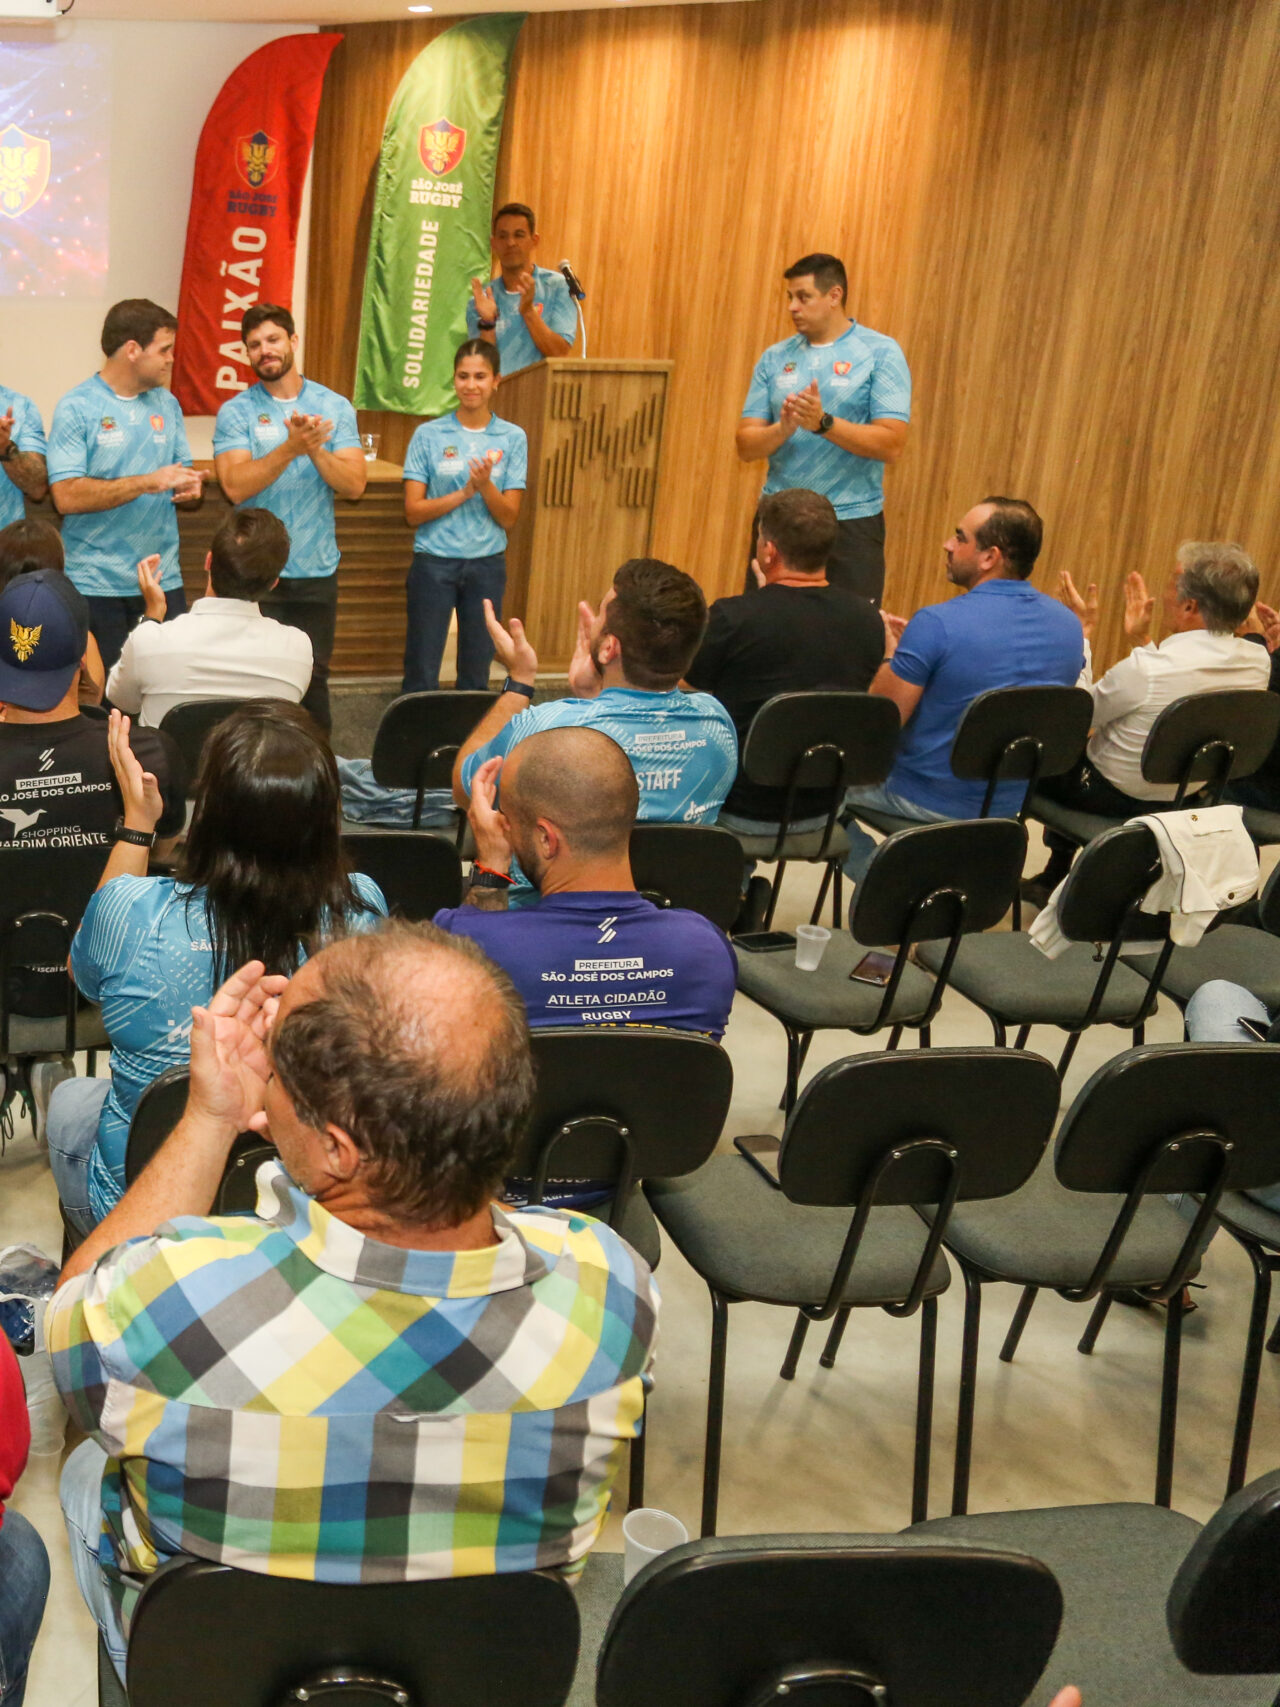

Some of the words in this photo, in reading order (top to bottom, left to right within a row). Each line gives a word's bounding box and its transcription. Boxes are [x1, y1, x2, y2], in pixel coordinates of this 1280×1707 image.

[411, 177, 434, 190] SÃO
[433, 181, 463, 194] JOSÉ
[409, 190, 463, 208] RUGBY
[227, 201, 277, 217] RUGBY
[215, 226, 267, 391] PAIXÃO
[402, 219, 439, 389] SOLIDARIEDADE
[654, 744, 672, 752] DOS
[673, 739, 707, 752] CAMPOS
[20, 775, 78, 789] PREFEITURA
[635, 768, 682, 791] STAFF
[12, 789, 40, 801] JOSÉ
[41, 788, 65, 797] DOS
[66, 782, 112, 794] CAMPOS
[21, 825, 82, 839] SHOPPING
[50, 832, 109, 848] ORIENTE
[579, 960, 640, 970] PREFEITURA
[541, 971, 567, 982] SÃO
[568, 971, 598, 982] JOSÉ
[600, 972, 625, 982] DOS
[626, 968, 674, 980] CAMPOS
[547, 994, 601, 1005] ATLETA
[604, 990, 666, 1004] CIDADÃO
[581, 1010, 632, 1021] RUGBY
